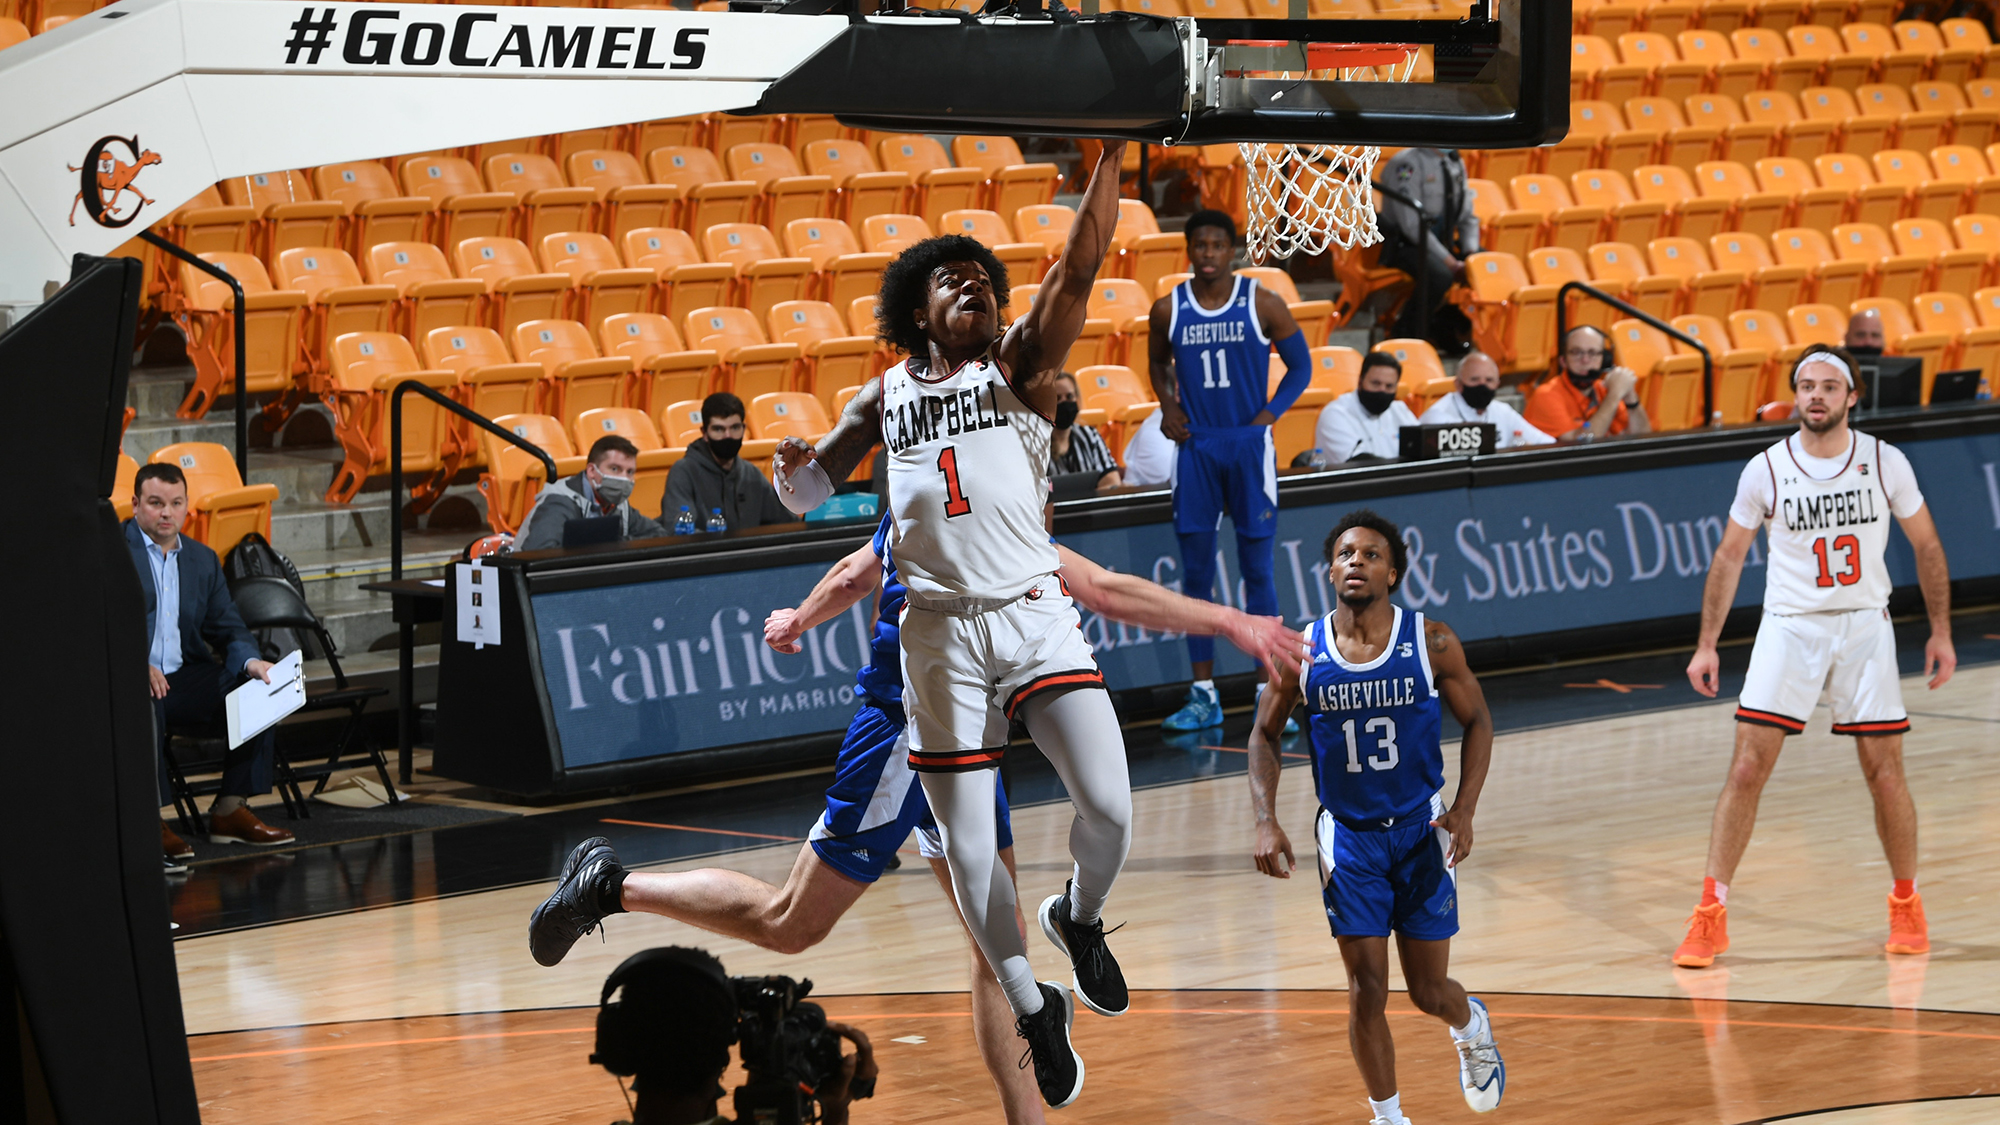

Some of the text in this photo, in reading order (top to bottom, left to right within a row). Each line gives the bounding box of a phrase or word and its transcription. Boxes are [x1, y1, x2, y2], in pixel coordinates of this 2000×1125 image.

[1181, 321, 1245, 346] ASHEVILLE
[1200, 348, 1231, 388] 11
[884, 381, 1008, 454] CAMPBELL
[1438, 426, 1482, 450] POSS
[937, 445, 972, 519] 1
[1783, 488, 1878, 531] CAMPBELL
[1400, 526, 1450, 609] &
[1455, 516, 1613, 601] Suites
[1812, 533, 1861, 588] 13
[719, 684, 854, 722] BY MARRIO
[1318, 677, 1415, 711] ASHEVILLE
[1341, 716, 1400, 773] 13
